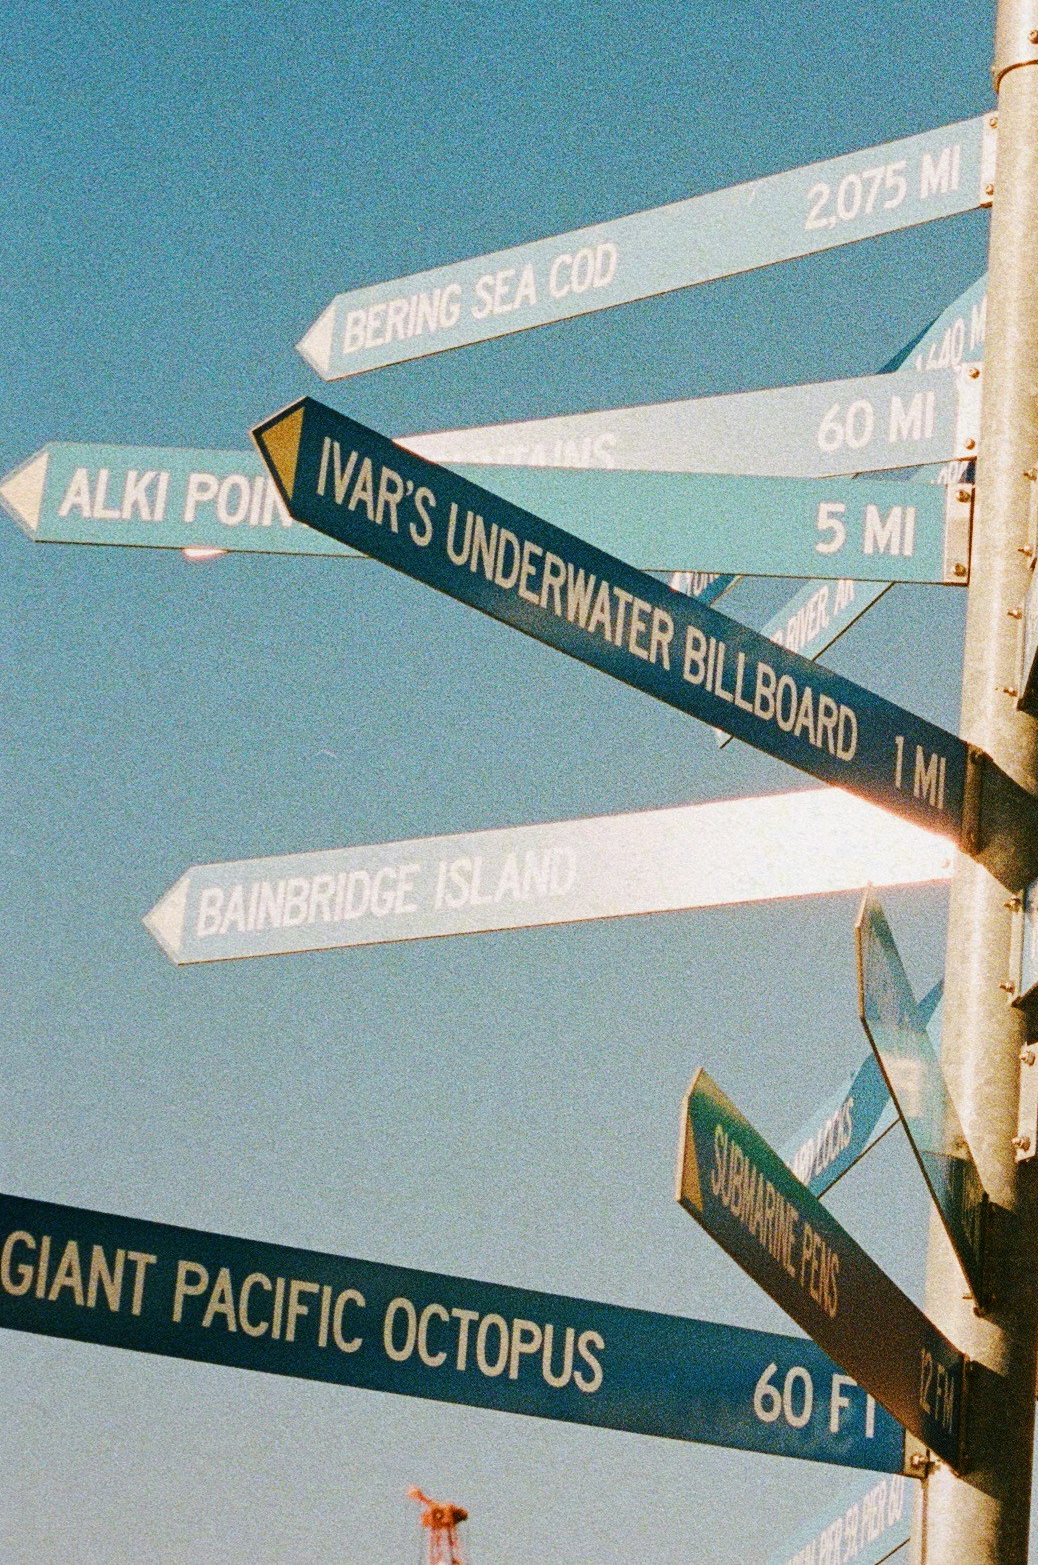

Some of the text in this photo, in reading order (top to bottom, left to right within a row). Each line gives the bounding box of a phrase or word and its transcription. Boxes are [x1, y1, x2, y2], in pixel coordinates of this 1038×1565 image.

[342, 145, 961, 355] BERING SEA COD 2,075 MI
[58, 467, 916, 557] ALKI POIN 5 MI
[816, 398, 873, 454] 60
[887, 392, 936, 443] MI
[316, 436, 947, 810] IVAR'S UNDERWATER BILLBOARD 1 MI
[196, 847, 578, 938] BAINBRIDGE ISLAND
[711, 1124, 799, 1278] SUBMARINE
[801, 1222, 840, 1320] PENS
[0, 1229, 157, 1316] GIANT
[172, 1260, 367, 1354] PACIFIC
[384, 1296, 606, 1394] OCTOPUS
[753, 1361, 814, 1429] 60
